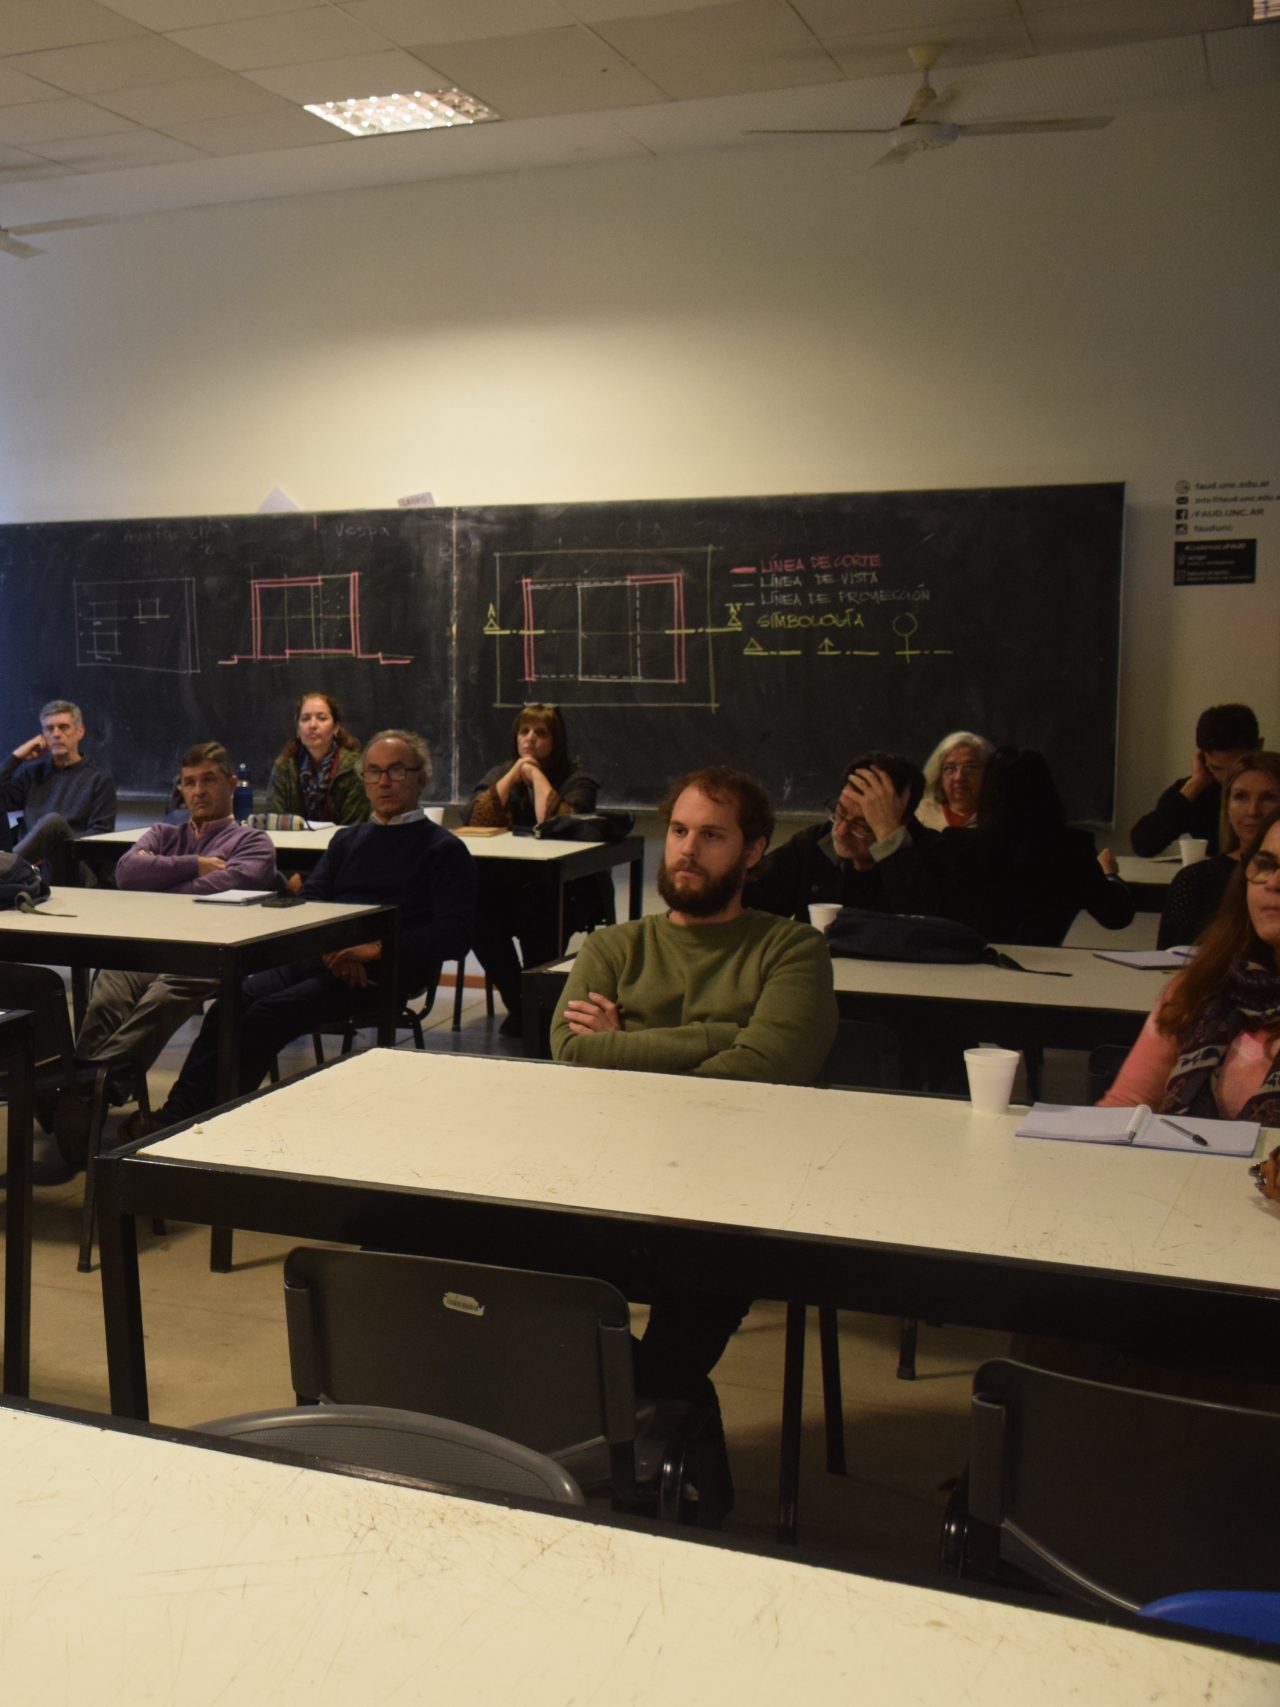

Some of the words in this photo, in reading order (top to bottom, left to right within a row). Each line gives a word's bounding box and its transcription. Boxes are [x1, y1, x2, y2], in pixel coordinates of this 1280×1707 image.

[810, 555, 831, 569] DE
[833, 554, 882, 568] CORTE
[814, 573, 836, 585] DE
[841, 570, 878, 585] VISTA
[808, 592, 831, 605] DE
